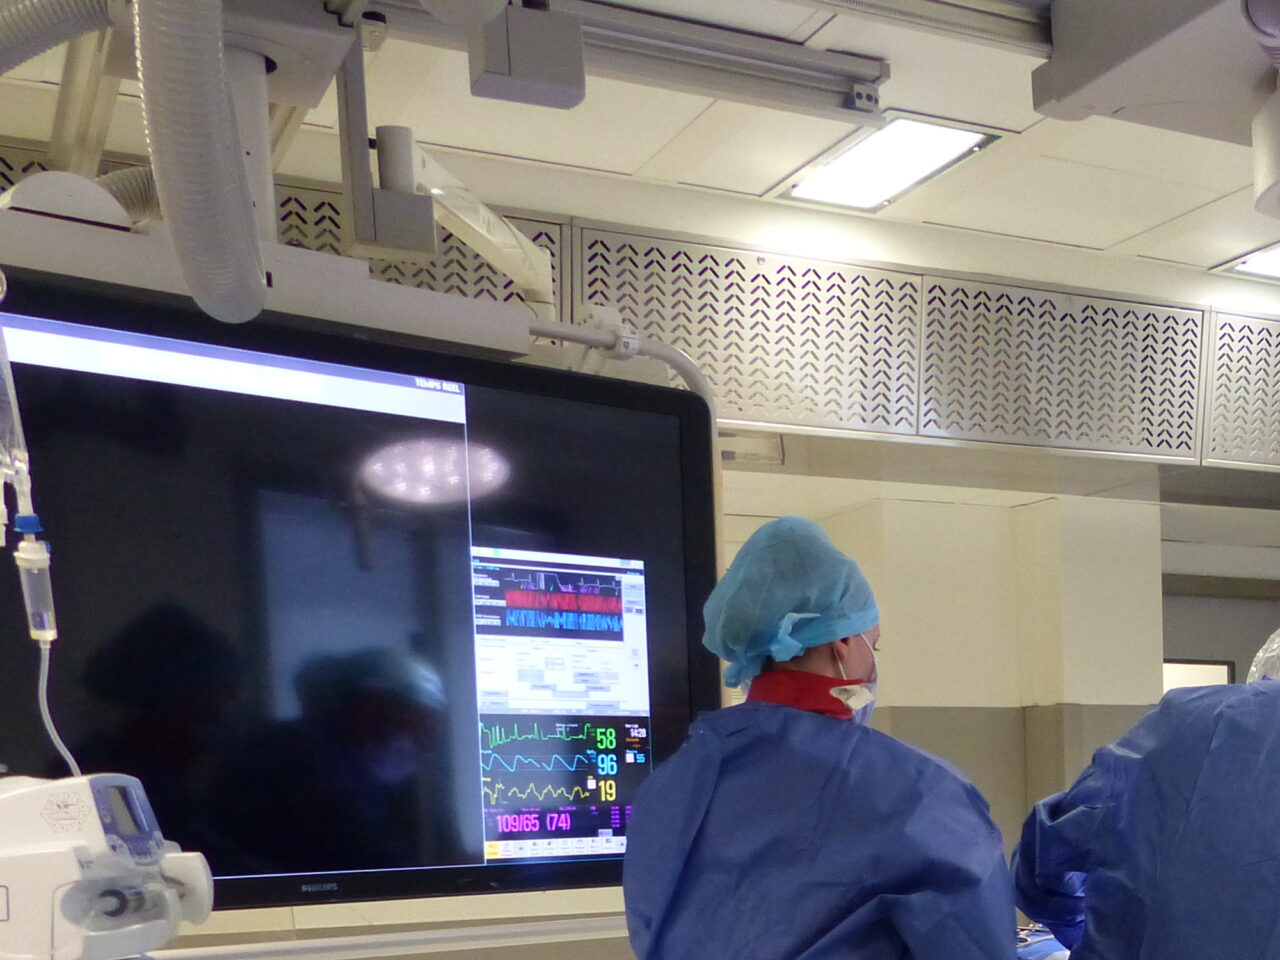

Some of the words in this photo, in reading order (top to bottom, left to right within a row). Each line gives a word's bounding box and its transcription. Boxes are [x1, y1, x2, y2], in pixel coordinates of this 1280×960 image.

[596, 728, 616, 749] 58
[597, 754, 618, 775] 96
[598, 780, 616, 801] 19
[496, 814, 540, 833] 109/65
[546, 813, 571, 831] (74)
